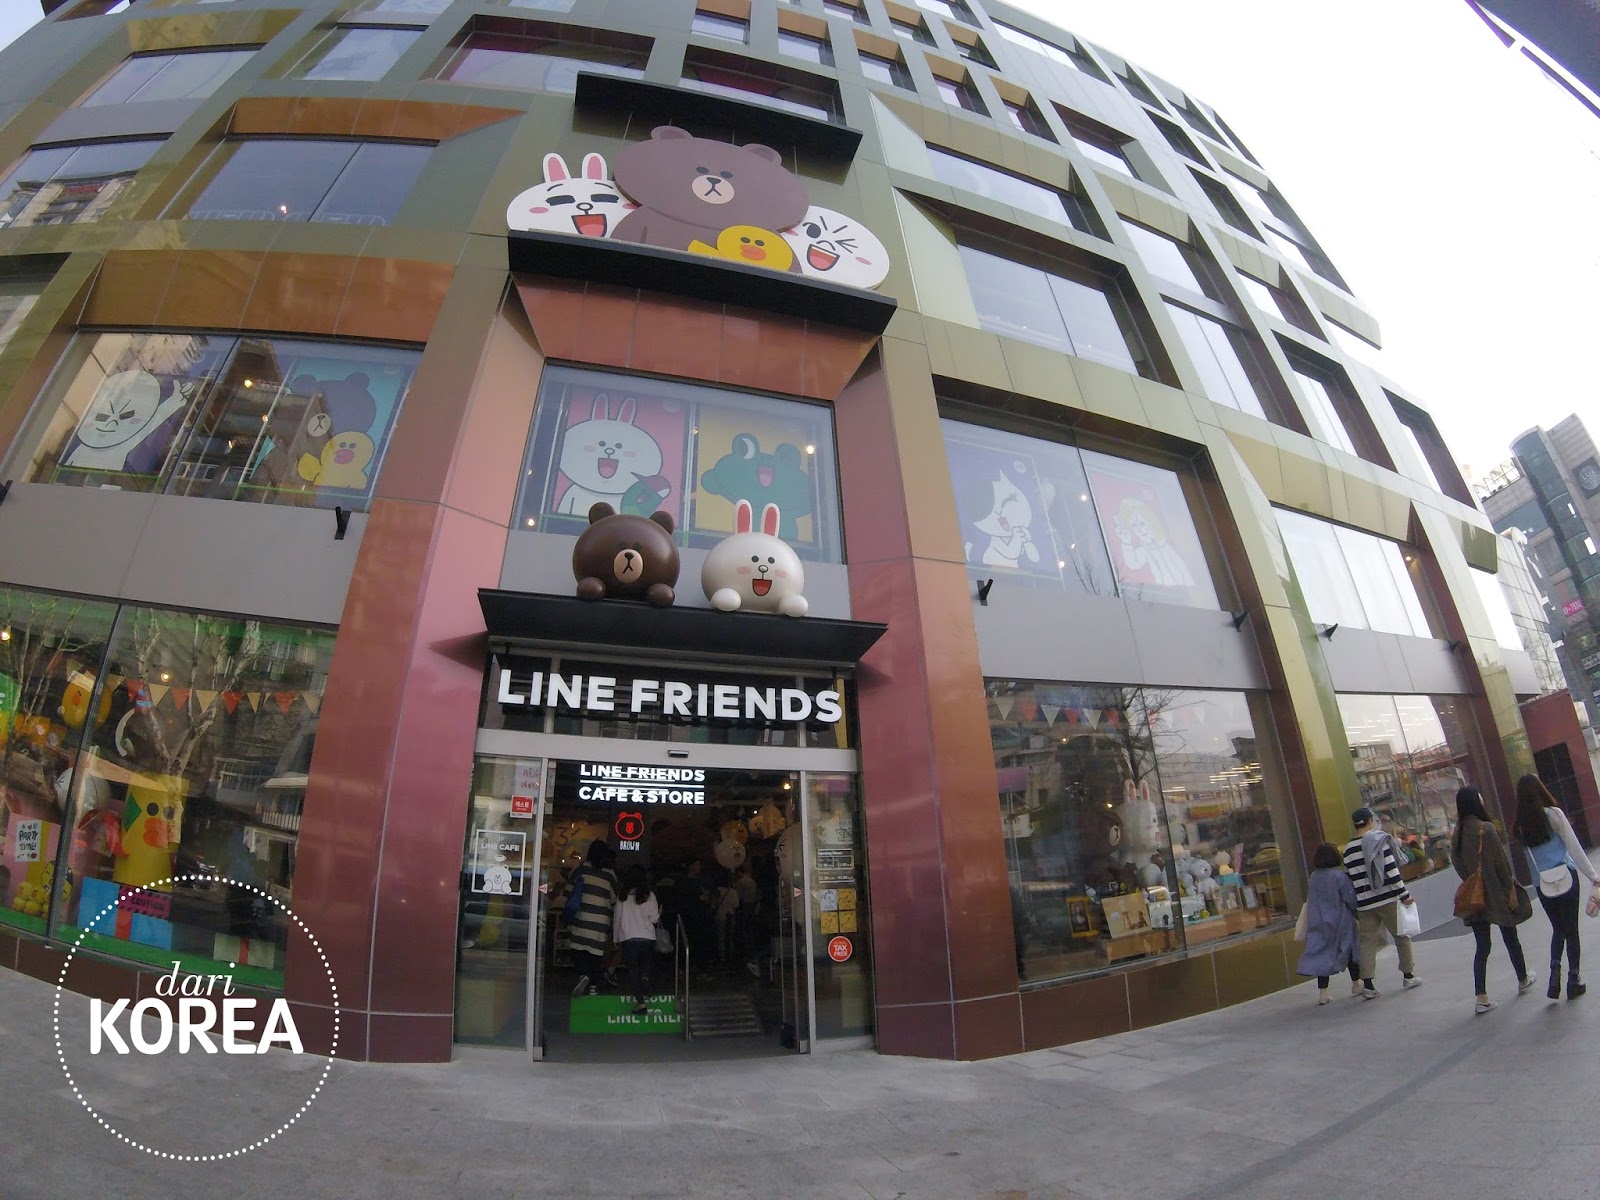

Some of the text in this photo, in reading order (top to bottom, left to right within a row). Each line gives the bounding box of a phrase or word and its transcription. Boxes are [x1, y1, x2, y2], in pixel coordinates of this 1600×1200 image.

[498, 669, 843, 723] LINE FRIENDS
[580, 764, 706, 782] LINE FRIENDS
[579, 786, 705, 805] CAFE & STORE
[18, 830, 39, 842] PARTY
[499, 844, 520, 852] CAFE
[620, 841, 640, 851] BROWN
